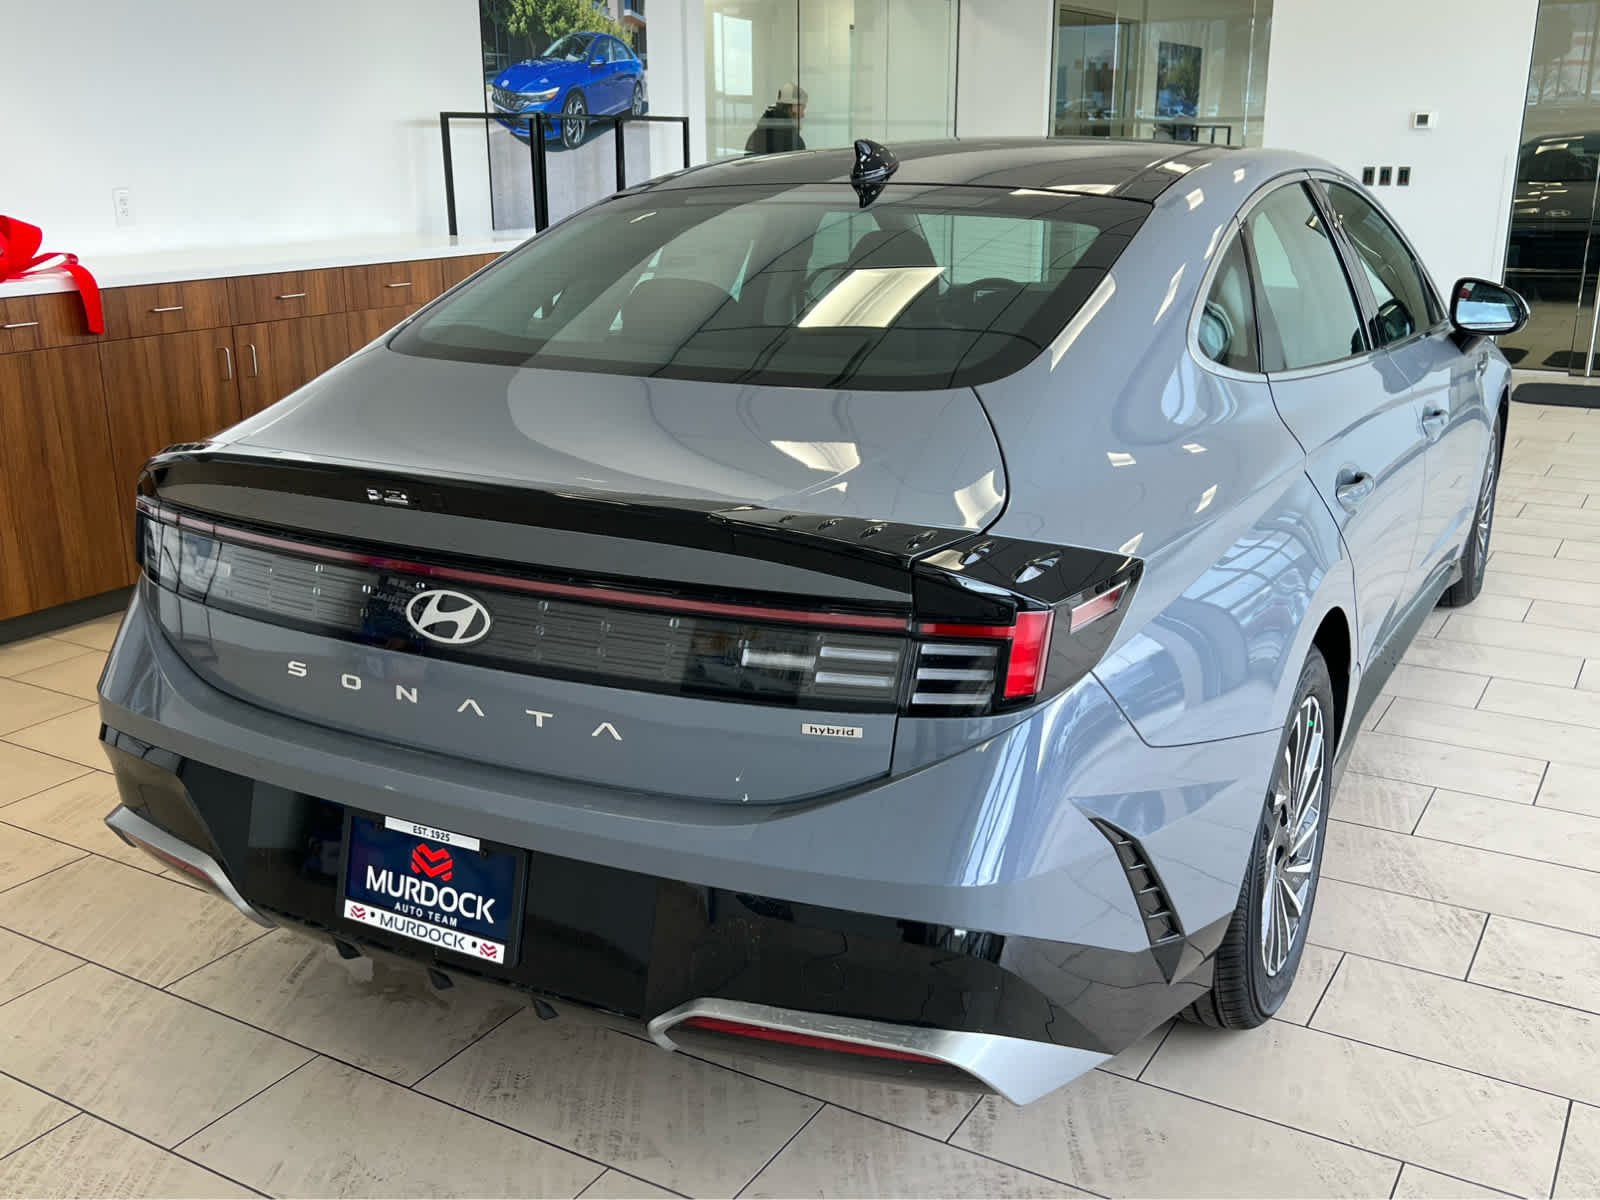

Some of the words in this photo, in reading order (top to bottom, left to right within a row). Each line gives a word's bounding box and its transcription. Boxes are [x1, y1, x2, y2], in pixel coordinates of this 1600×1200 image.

[287, 660, 624, 741] SONATA
[809, 725, 855, 736] hybrid
[412, 825, 429, 837] EST.
[430, 829, 451, 842] 1925
[366, 865, 496, 924] MURDOCK
[394, 902, 424, 918] AUTO
[428, 911, 458, 927] TEAM
[379, 913, 467, 950] MURDOCK
